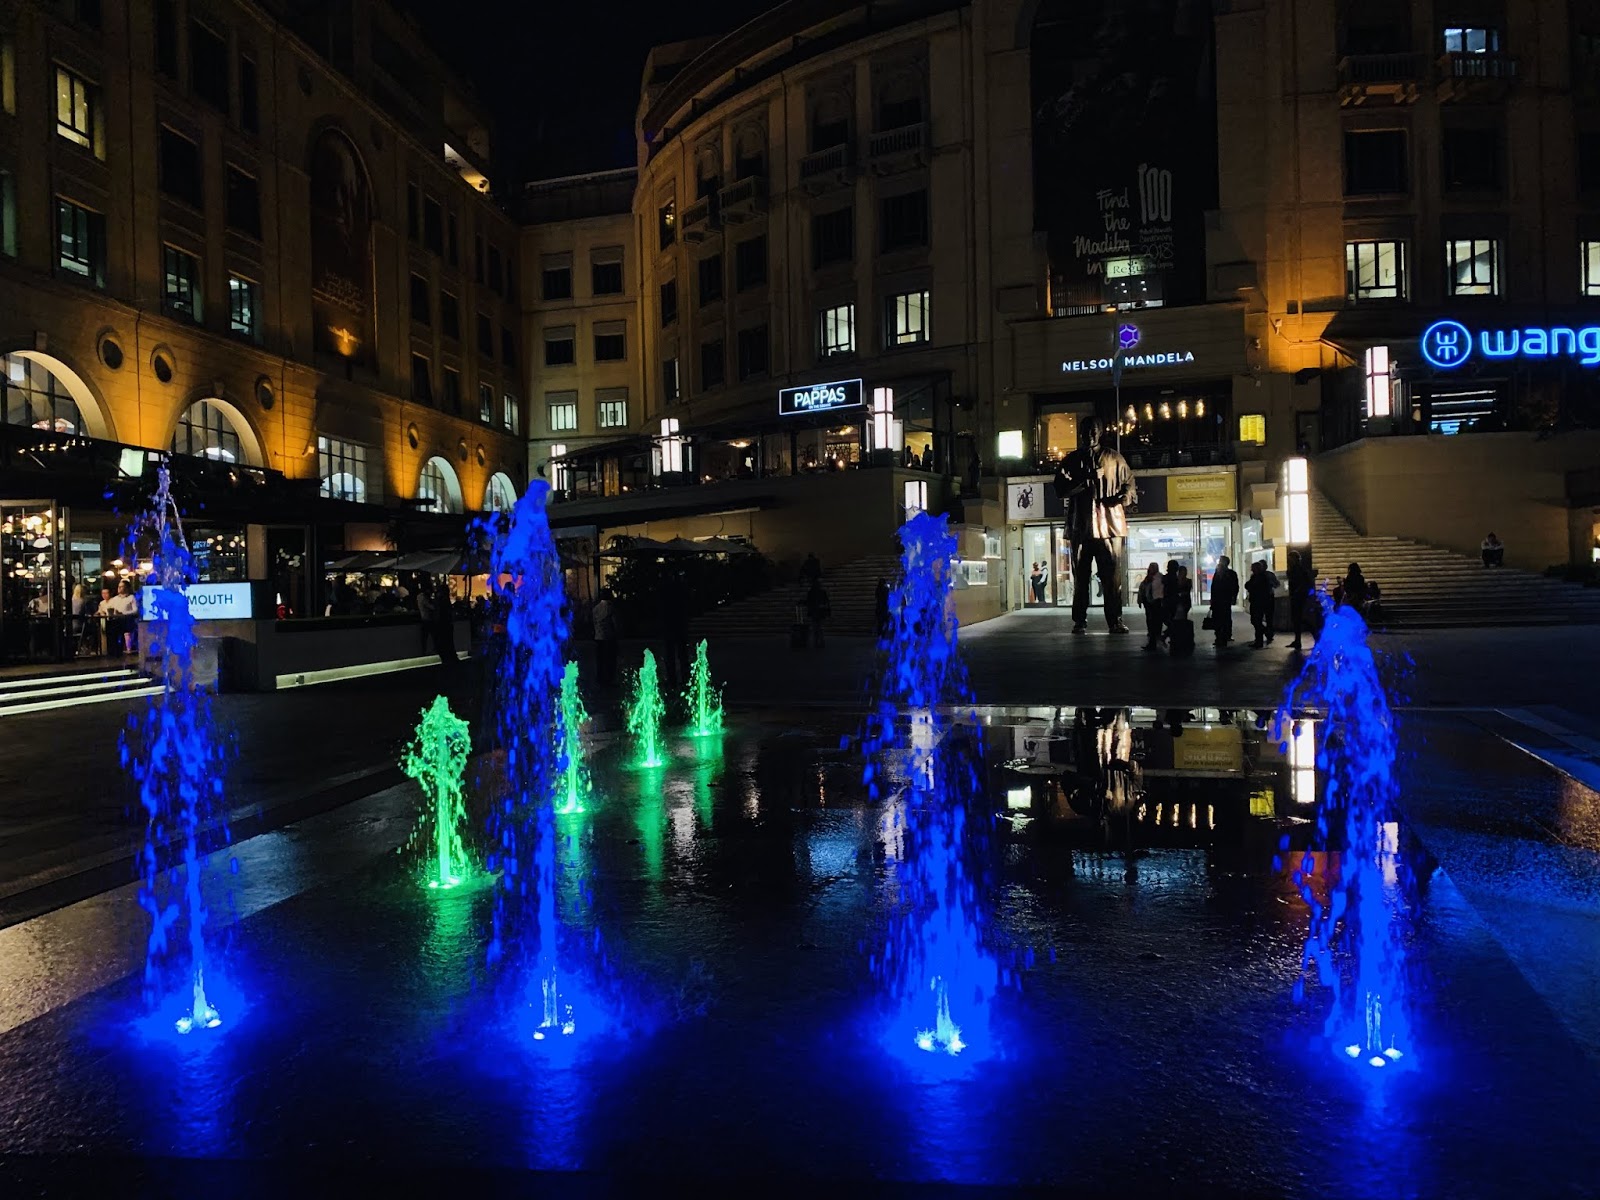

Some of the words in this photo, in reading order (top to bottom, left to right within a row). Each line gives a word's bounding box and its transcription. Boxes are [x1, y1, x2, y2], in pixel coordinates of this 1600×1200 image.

[1096, 187, 1130, 211] Find
[1137, 163, 1173, 225] 100
[1103, 211, 1131, 232] the
[1072, 232, 1131, 258] Madiba
[1140, 242, 1174, 260] 2018
[1086, 258, 1104, 275] in
[1480, 326, 1600, 365] wang
[1124, 351, 1195, 367] MANDELA
[793, 386, 847, 408] PAPPAS
[187, 593, 234, 606] MOUTH
